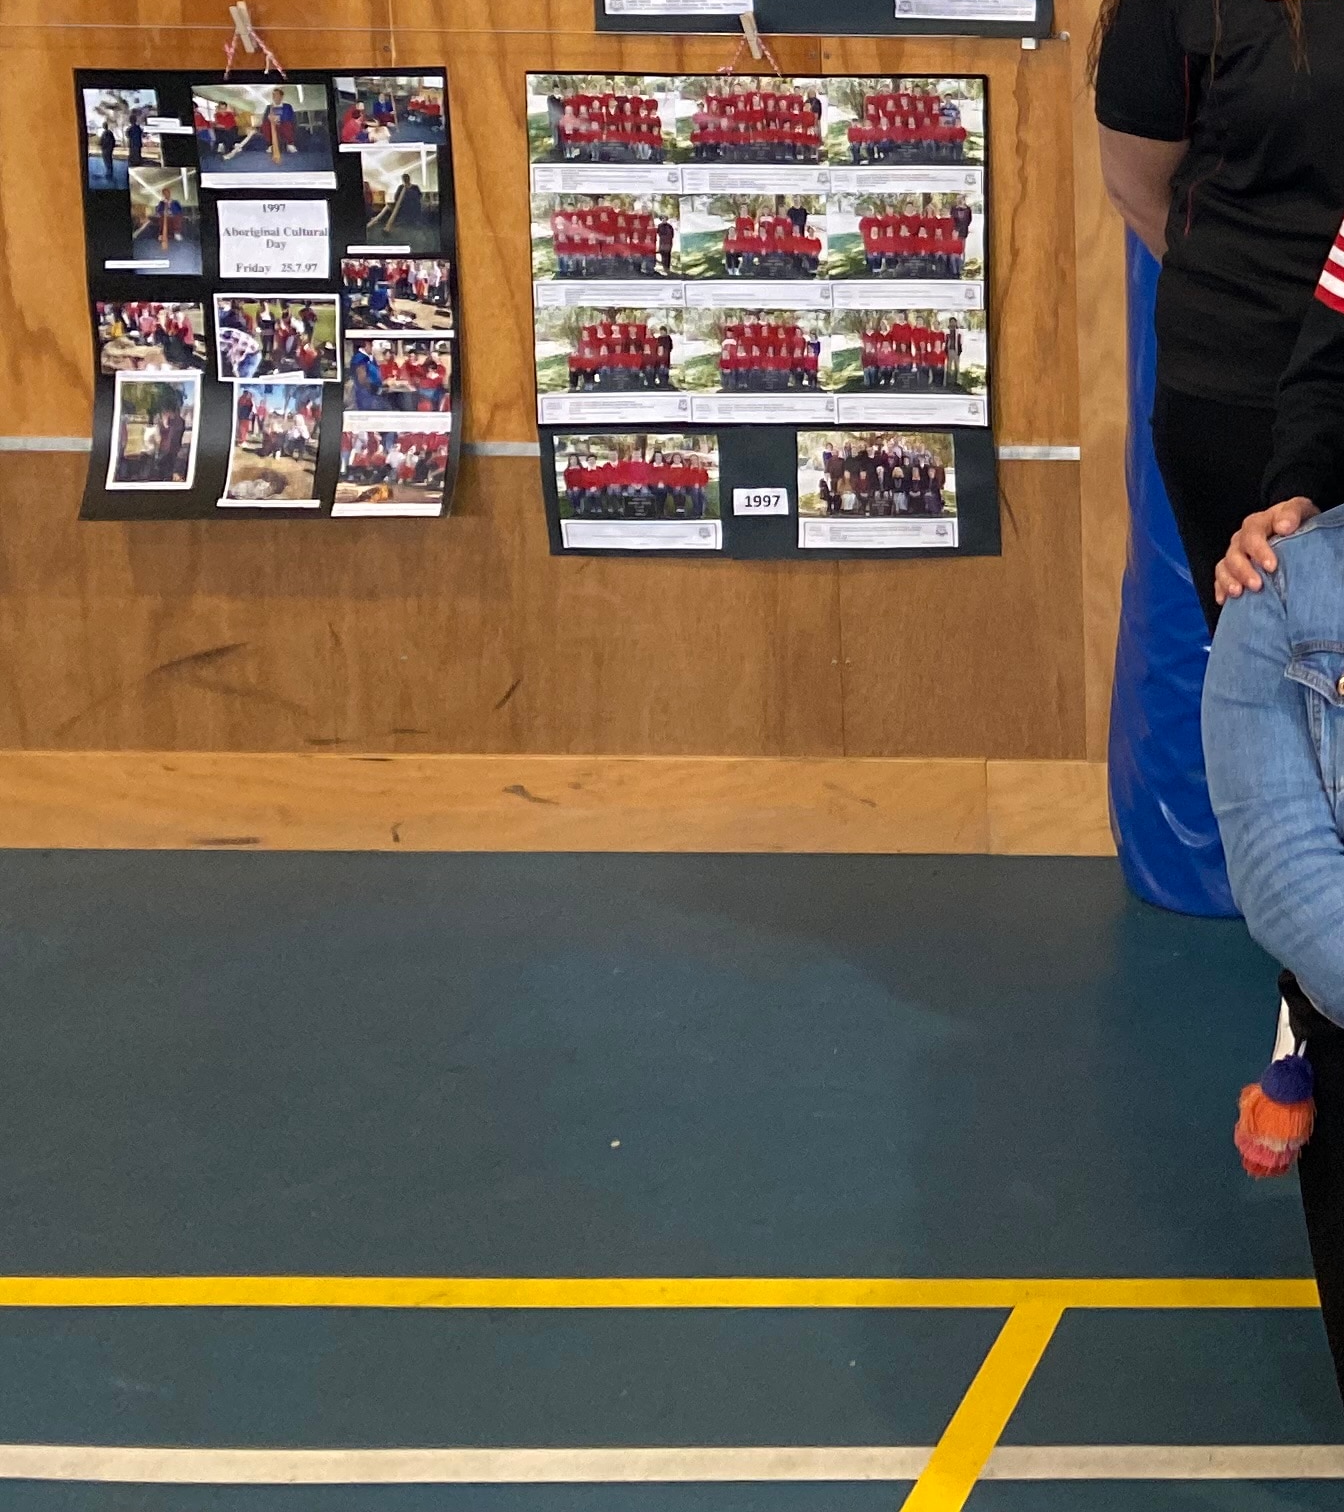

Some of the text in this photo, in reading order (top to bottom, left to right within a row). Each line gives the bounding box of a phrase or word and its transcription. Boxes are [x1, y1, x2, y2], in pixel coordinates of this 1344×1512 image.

[262, 203, 286, 213] 1997
[223, 227, 328, 238] Aboriginal Cultural
[266, 239, 287, 250] Day
[236, 263, 272, 275] Friday
[744, 494, 781, 507] 1997
